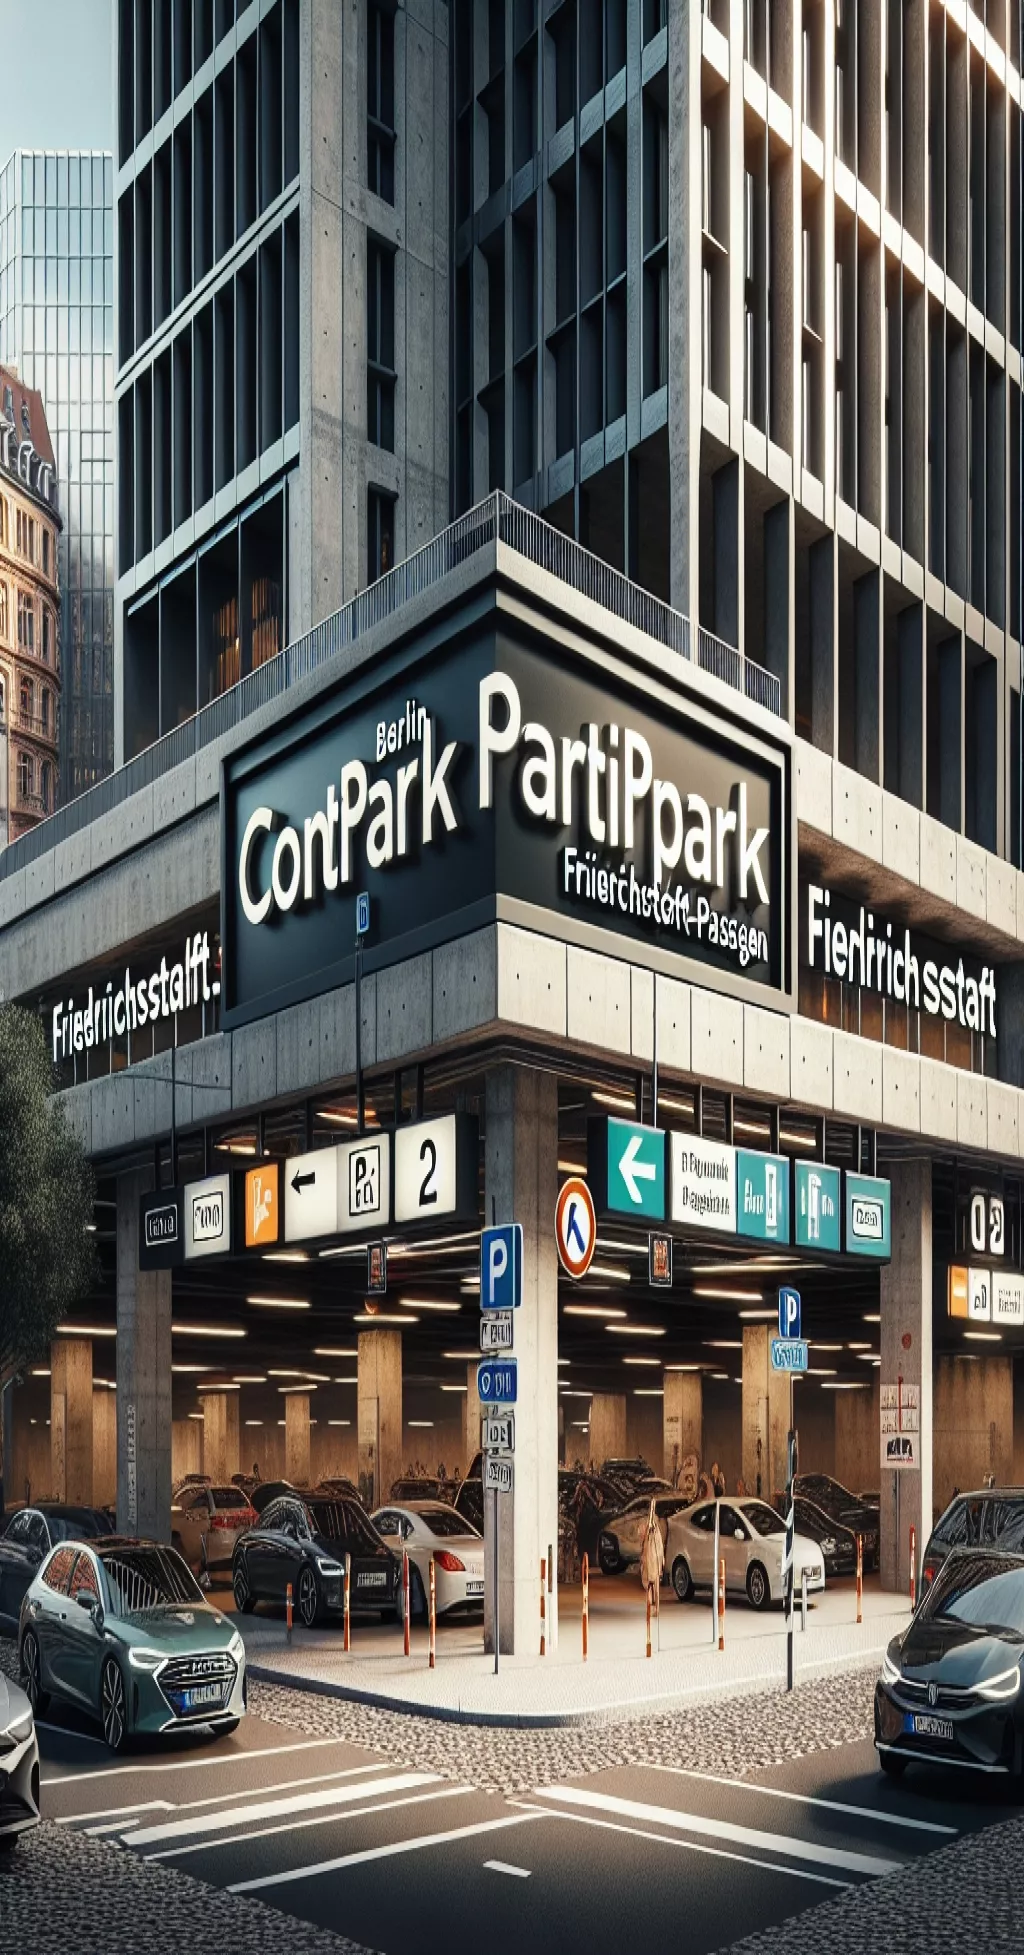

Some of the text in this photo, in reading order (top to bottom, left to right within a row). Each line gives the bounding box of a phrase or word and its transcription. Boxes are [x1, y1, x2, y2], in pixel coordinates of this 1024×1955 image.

[238, 716, 457, 925] ContPark
[479, 671, 770, 904] PartiPpark
[418, 1138, 438, 1206] 2
[489, 1238, 508, 1303] P
[786, 1294, 797, 1337] P
